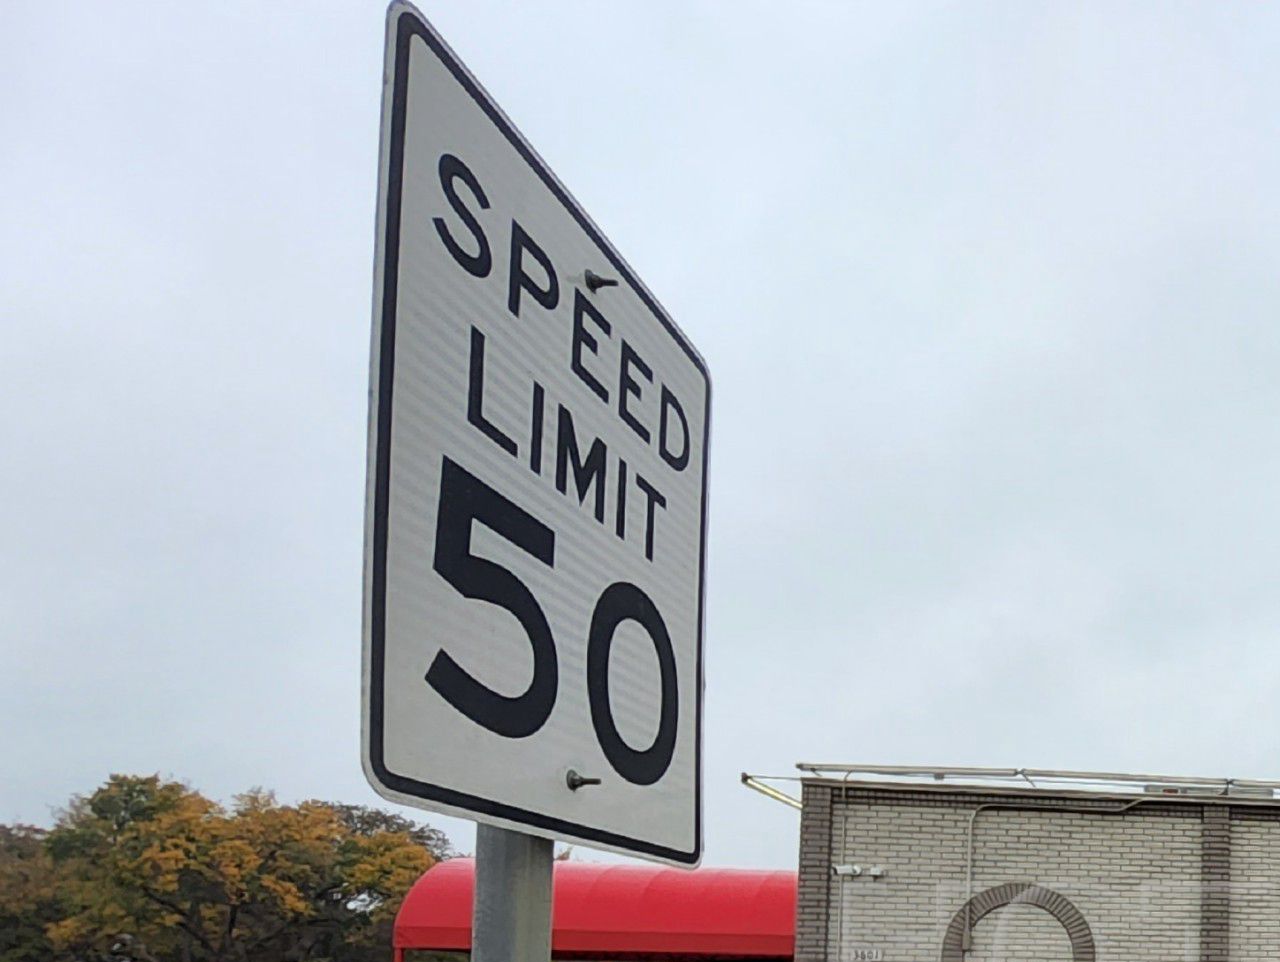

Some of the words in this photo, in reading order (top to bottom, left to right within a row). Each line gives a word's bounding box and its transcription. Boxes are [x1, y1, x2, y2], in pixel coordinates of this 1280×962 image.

[433, 153, 690, 472] SPEED
[467, 326, 667, 562] LIMIT
[425, 455, 679, 786] 50
